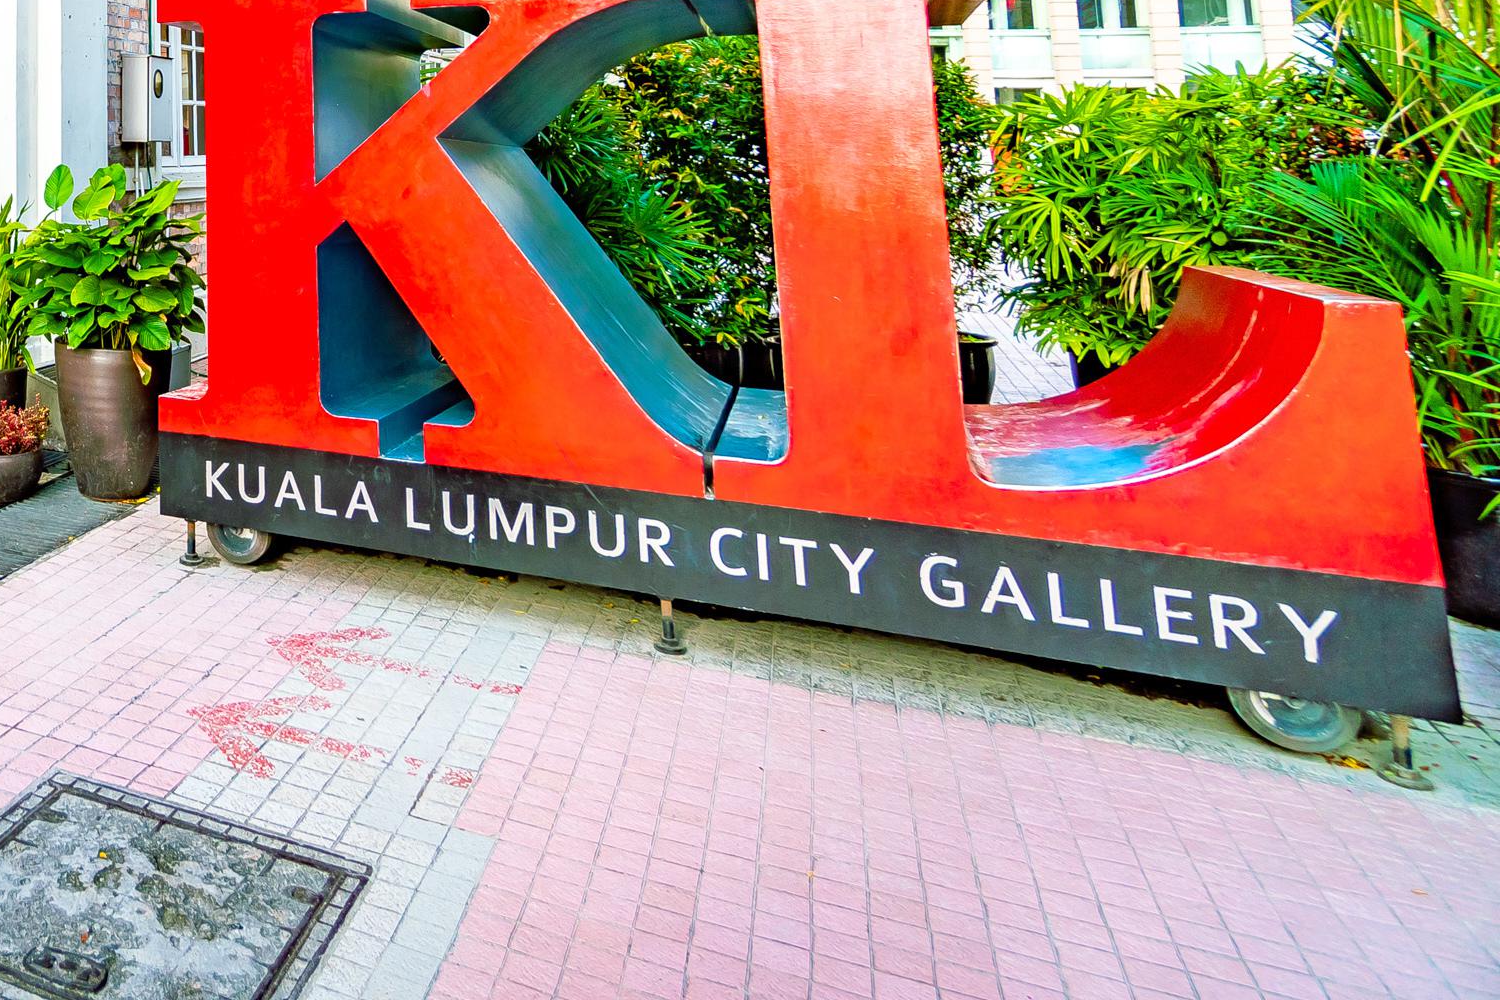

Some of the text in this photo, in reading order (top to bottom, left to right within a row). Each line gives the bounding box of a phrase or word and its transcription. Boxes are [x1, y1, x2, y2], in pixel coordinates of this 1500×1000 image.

[205, 459, 1339, 665] KUALA LUMPUR CITY GALLERY
